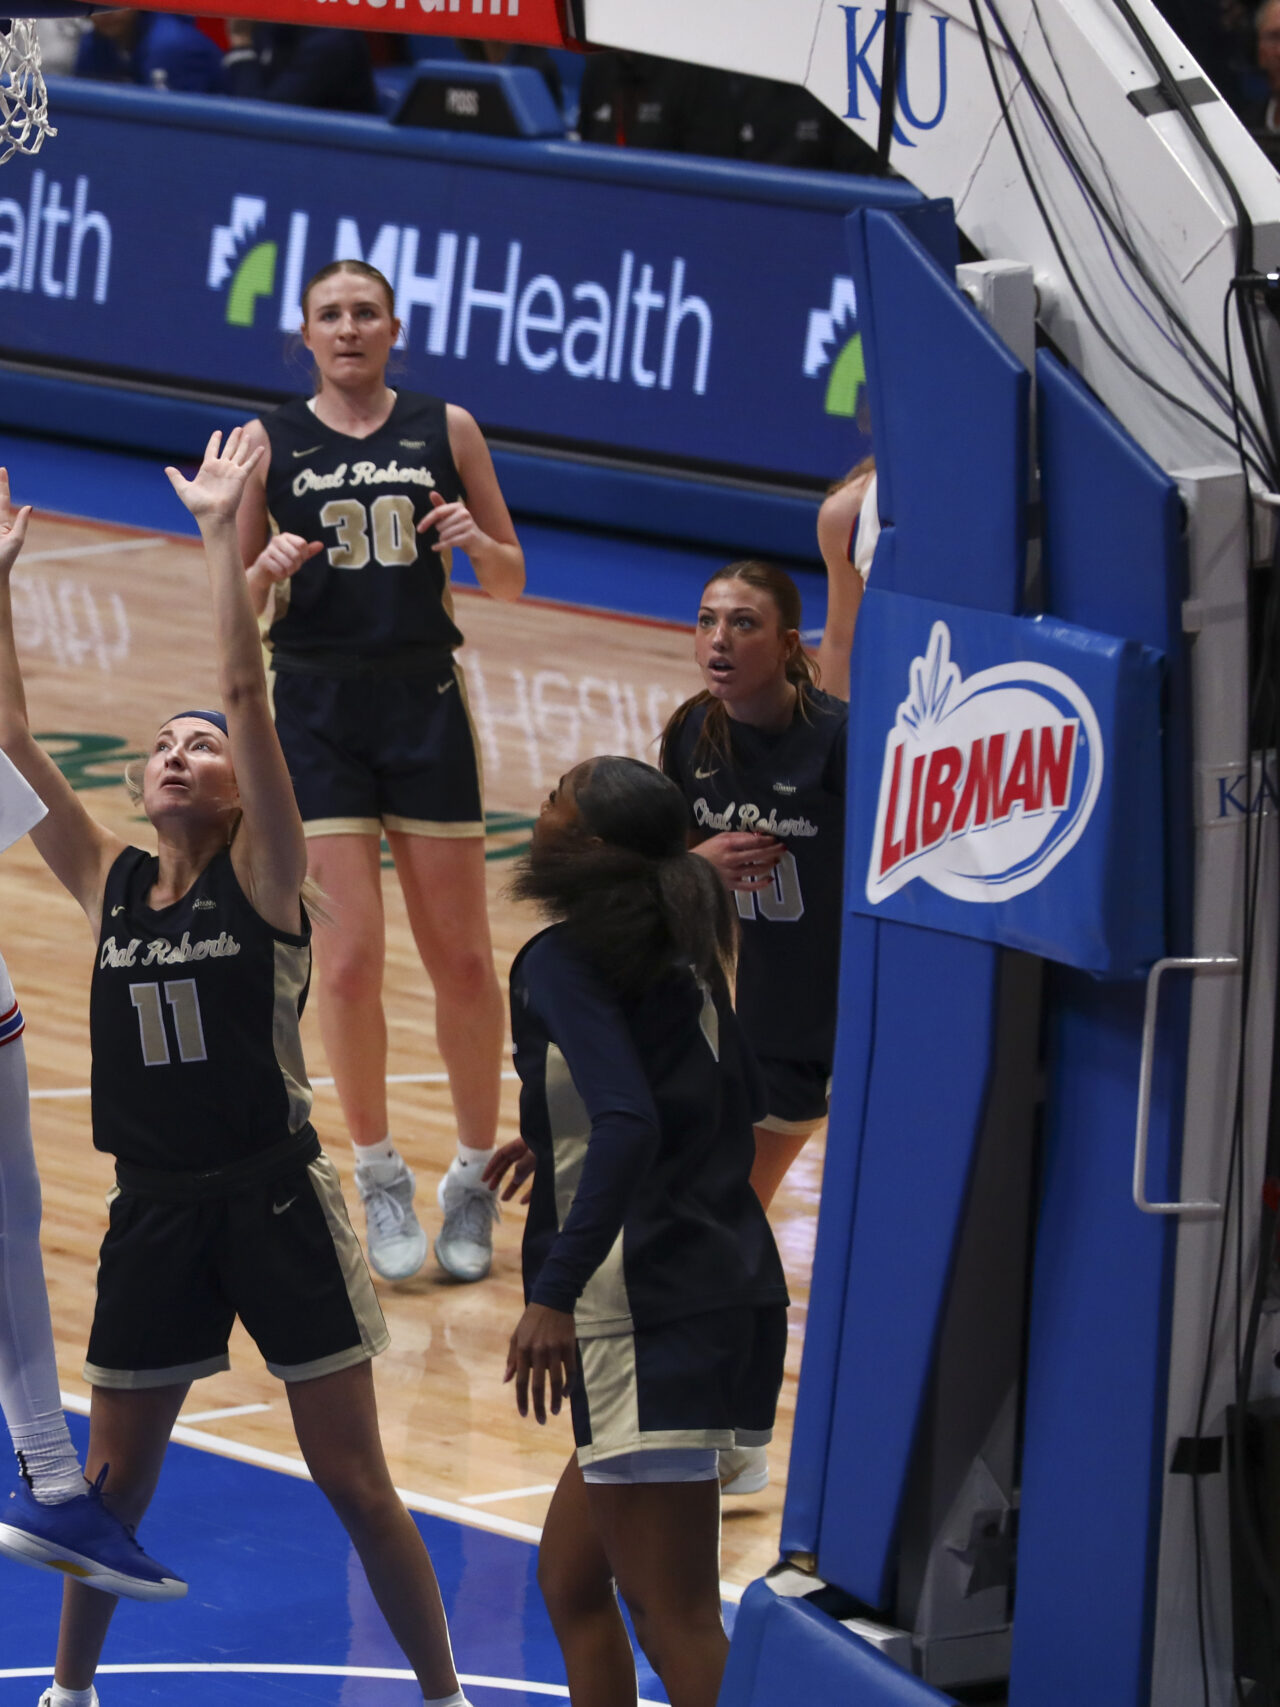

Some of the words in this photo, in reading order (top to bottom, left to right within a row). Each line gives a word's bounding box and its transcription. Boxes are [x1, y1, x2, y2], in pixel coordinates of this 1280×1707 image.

[837, 5, 950, 147] KU
[292, 463, 347, 497] Oral
[349, 460, 436, 488] Roberts
[320, 494, 418, 569] 30
[693, 797, 735, 832] Oral
[736, 803, 819, 837] Roberts
[879, 724, 1076, 877] LIBMAN
[100, 935, 143, 970] Oral
[141, 931, 241, 967] Roberts
[128, 978, 209, 1067] 11
